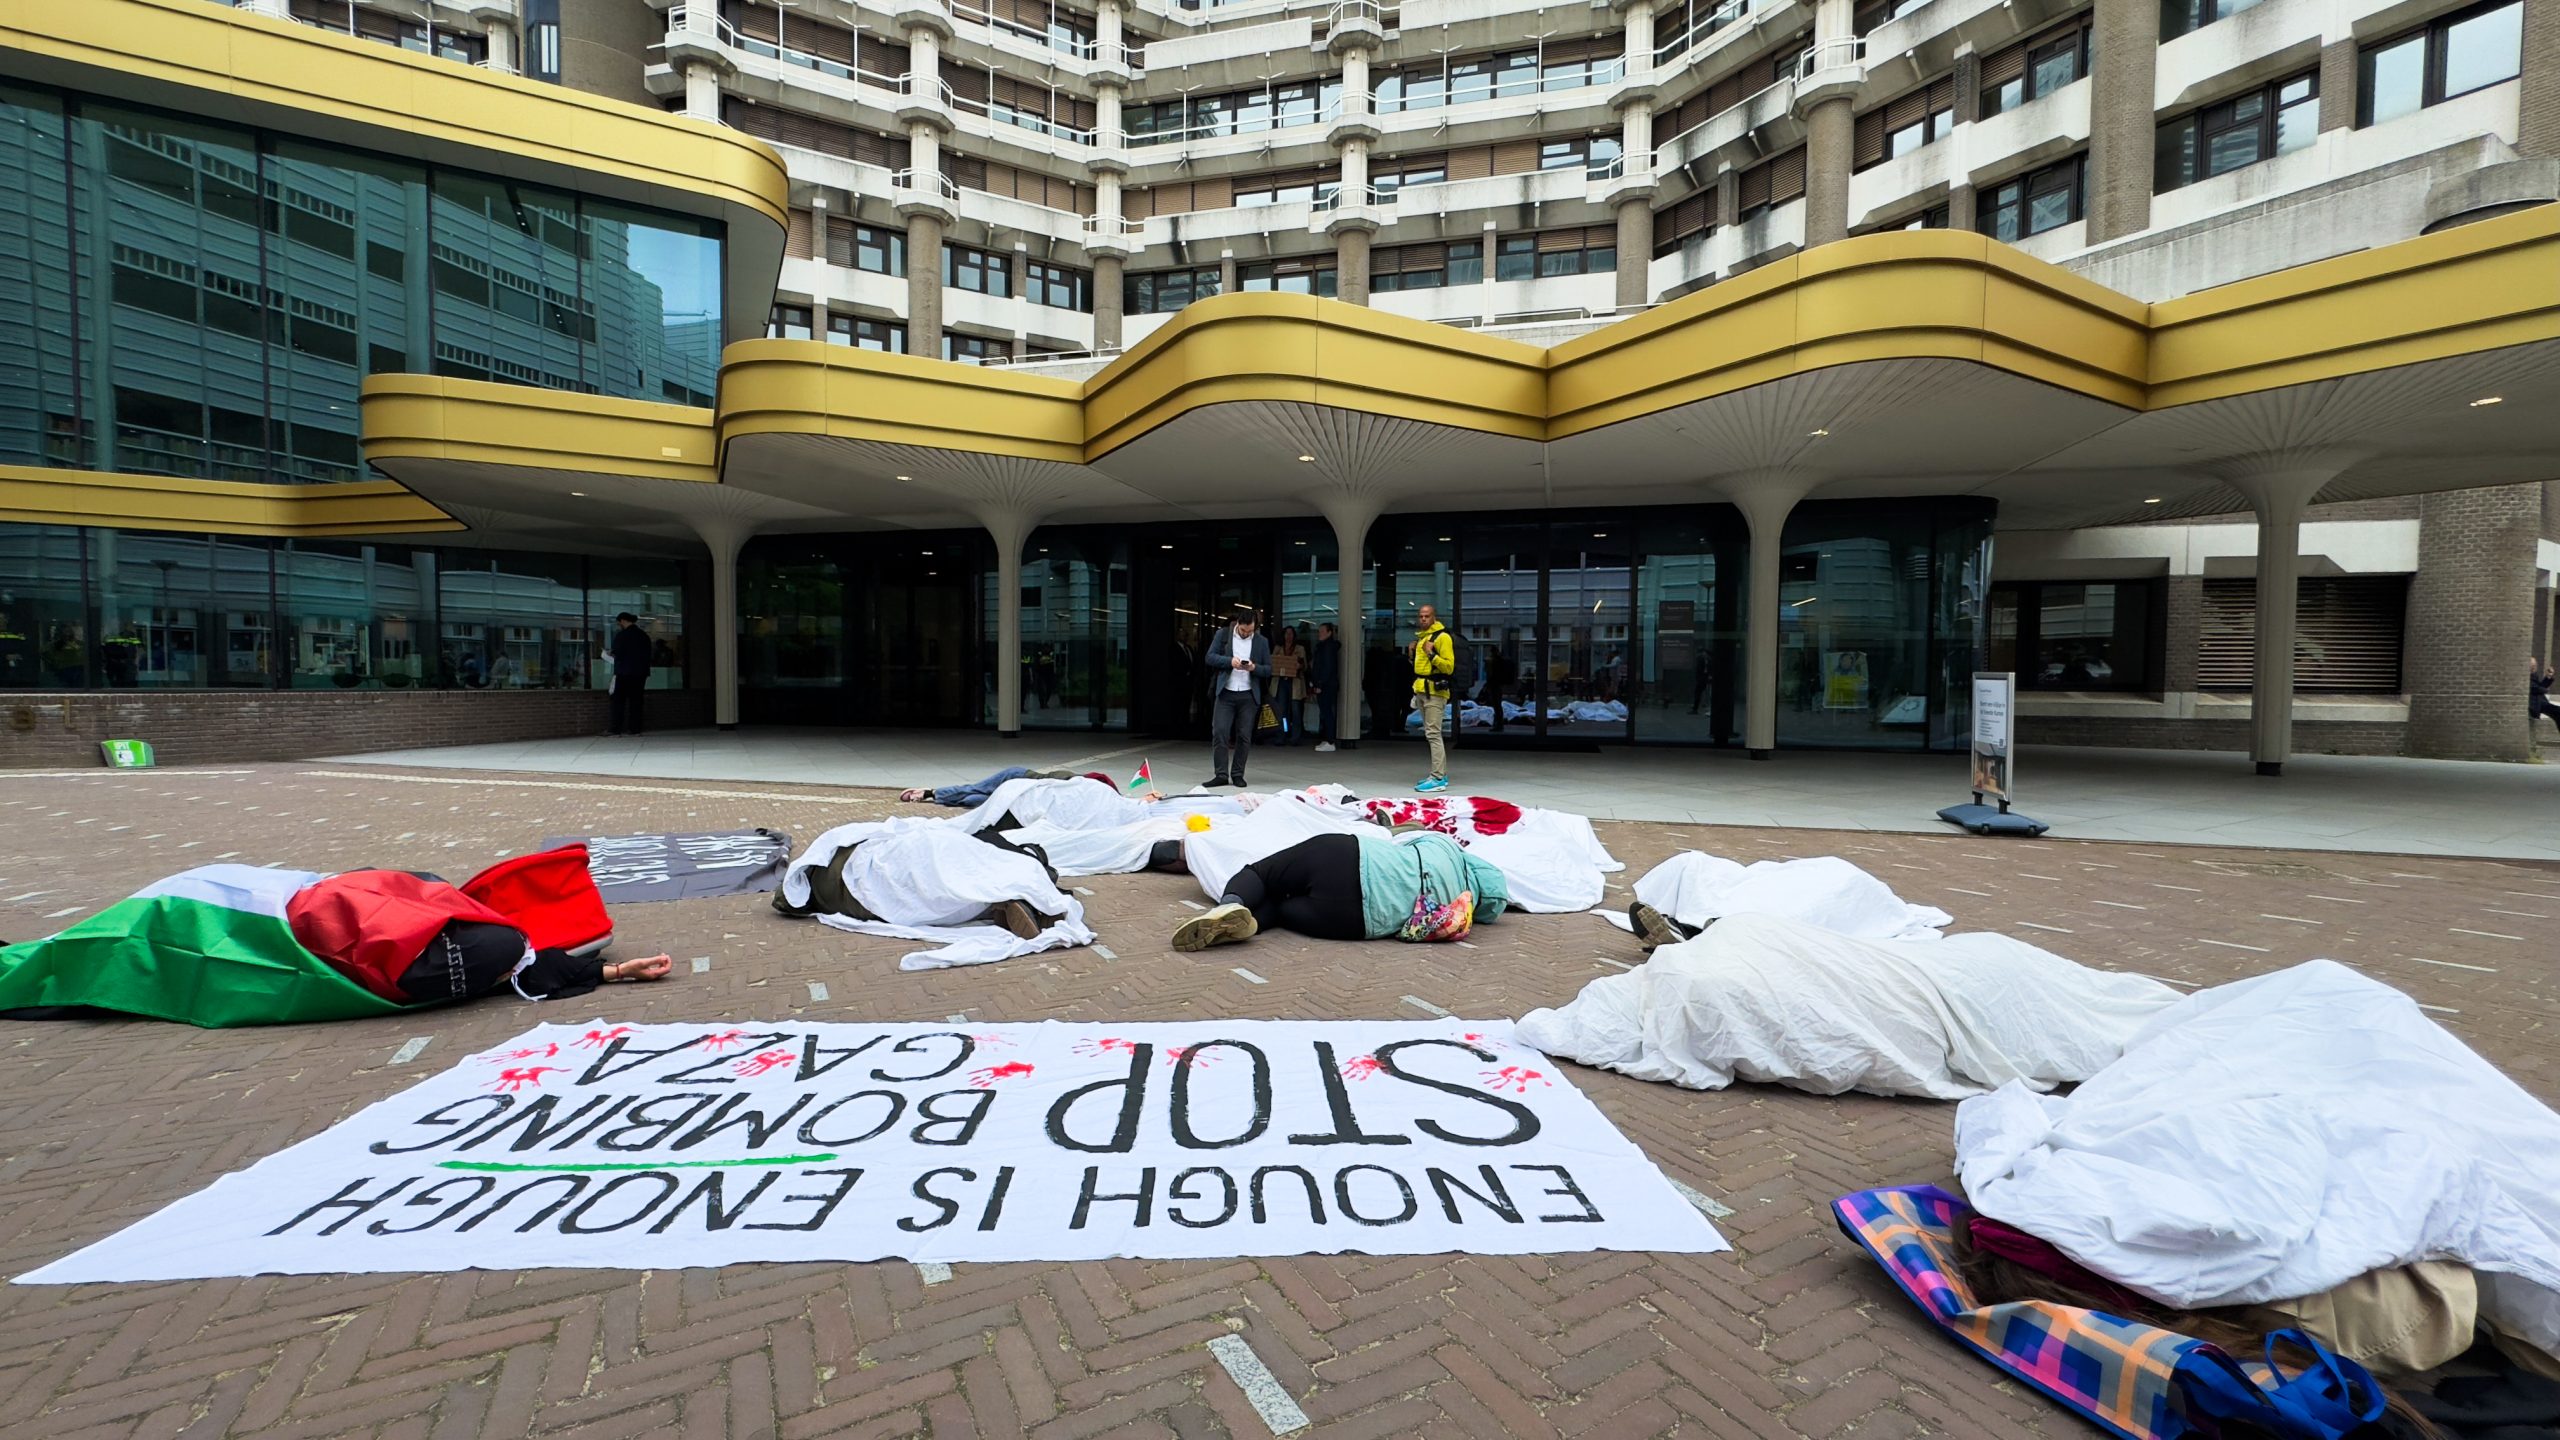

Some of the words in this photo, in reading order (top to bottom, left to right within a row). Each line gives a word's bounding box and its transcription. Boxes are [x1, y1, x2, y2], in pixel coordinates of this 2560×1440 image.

[575, 1033, 976, 1085] GAZA
[370, 1089, 997, 1154] BOMBING
[1045, 1039, 1540, 1153] STOP
[263, 1168, 864, 1236] ENOUGH
[898, 1165, 1015, 1233] IS
[1069, 1164, 1604, 1230] ENOUGH
